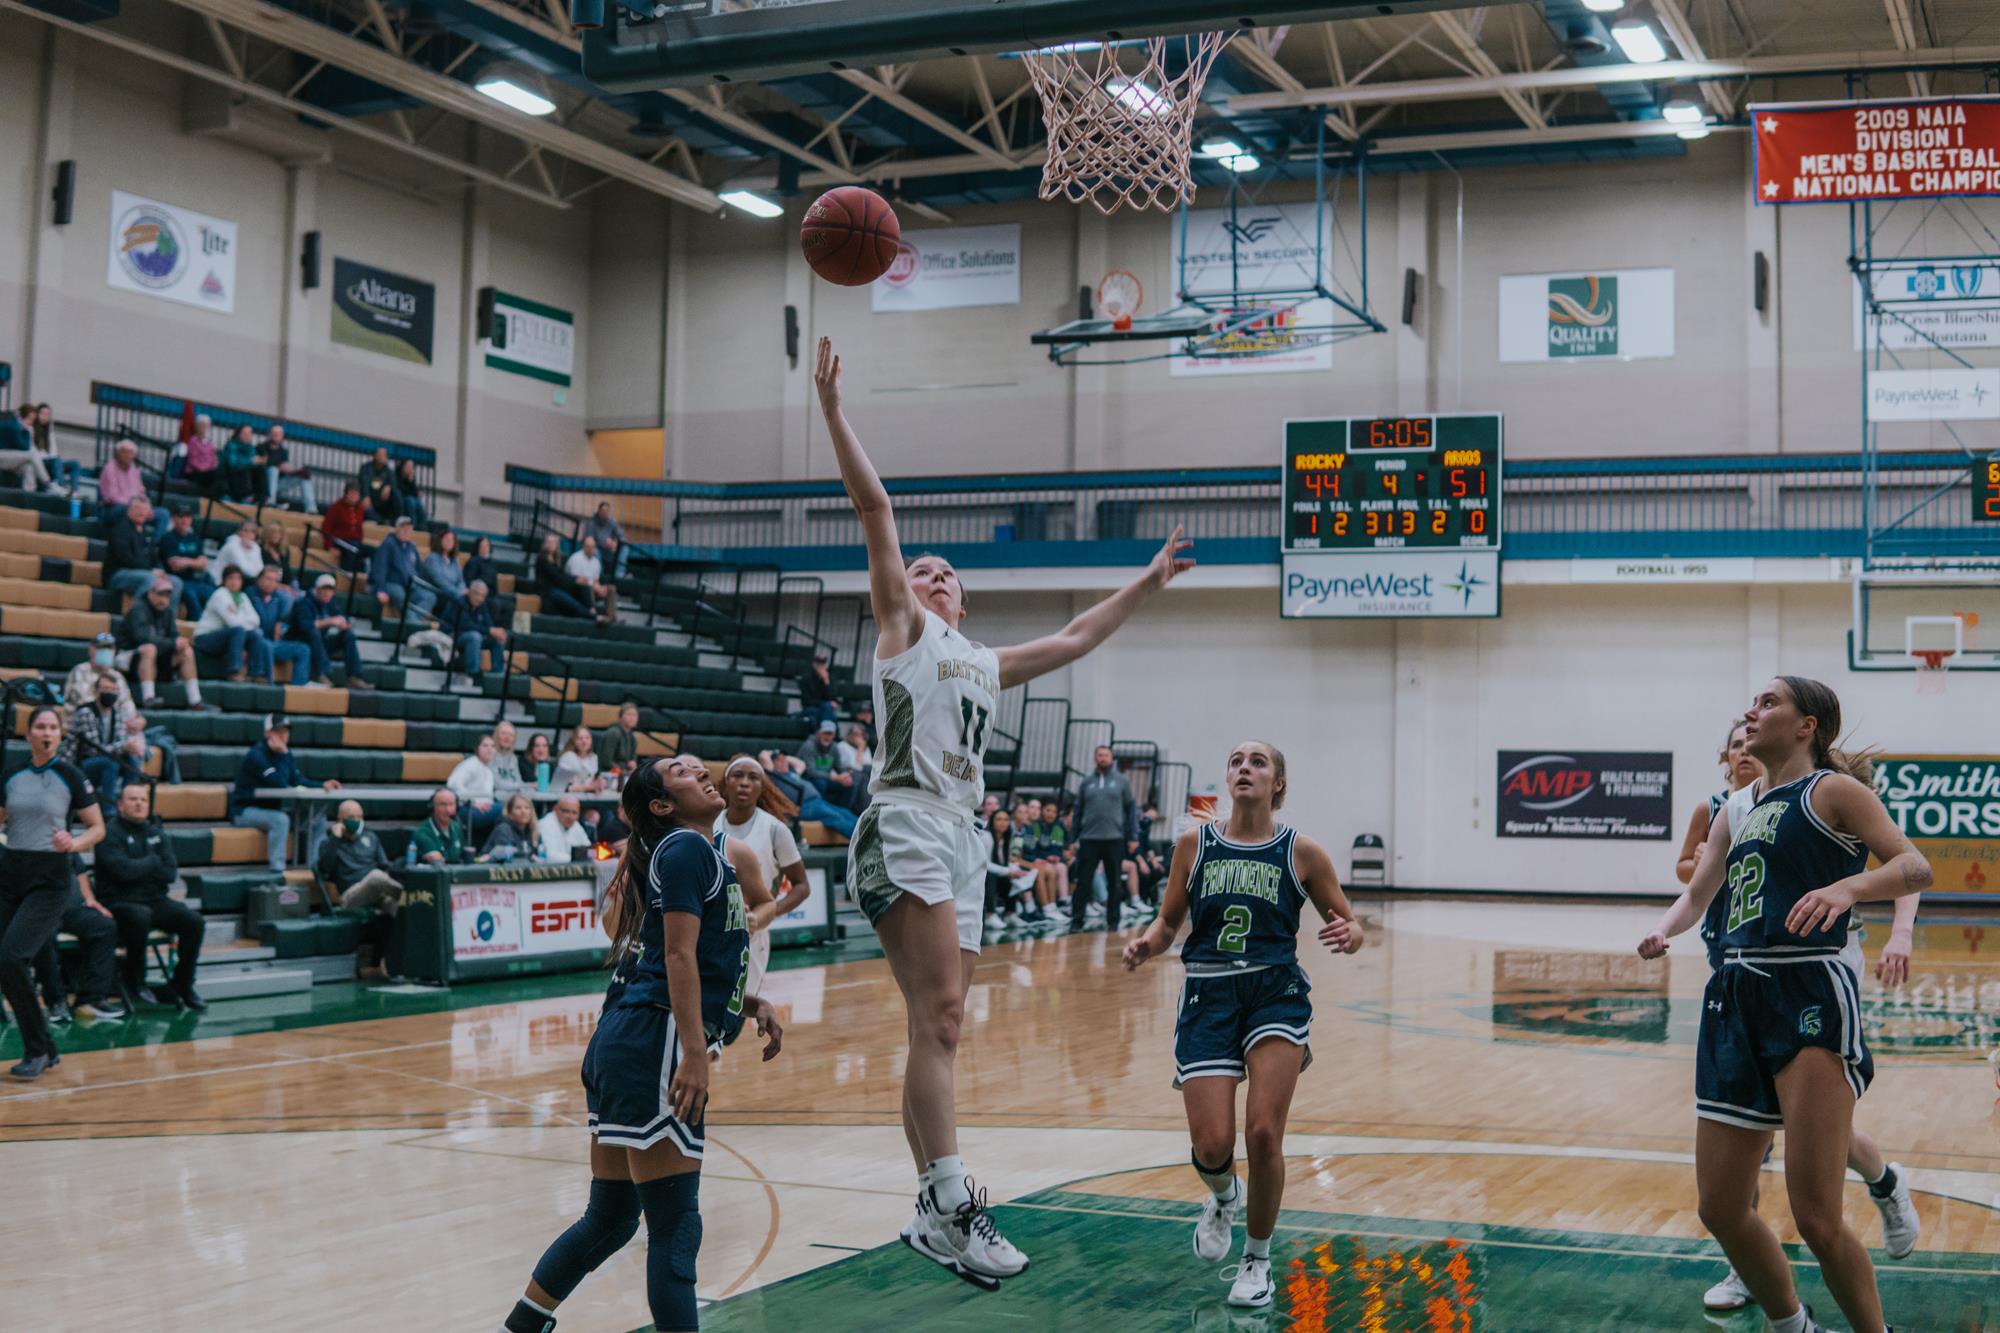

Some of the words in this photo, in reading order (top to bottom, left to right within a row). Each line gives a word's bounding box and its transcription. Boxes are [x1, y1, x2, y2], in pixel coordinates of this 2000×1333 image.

[1855, 107, 1909, 130] 2009
[1916, 105, 1966, 128] NAIA
[1856, 128, 1949, 151] DIVISION
[1957, 127, 1964, 147] I
[1800, 152, 1867, 175] MEN'S
[1793, 173, 1901, 197] NATIONAL
[922, 252, 957, 271] Office
[959, 248, 1016, 269] Solutions
[354, 278, 416, 315] Altana
[1550, 324, 1616, 346] QUALITY
[1570, 343, 1596, 354] INN
[1369, 420, 1429, 448] 6:05
[1295, 453, 1345, 470] ROCKY
[1375, 459, 1406, 471] PERIOD
[1305, 474, 1339, 497] 44
[1383, 474, 1398, 495] 4
[1450, 469, 1486, 497] 51
[1293, 502, 1321, 512] FOULS
[1360, 500, 1394, 511] PLAYER
[1397, 500, 1420, 511] FOUL
[1460, 498, 1488, 510] FOULS
[1311, 514, 1317, 534] 1
[1334, 512, 1348, 535] 2
[1432, 511, 1446, 535] 2
[1471, 510, 1484, 533] 0
[1374, 537, 1405, 547] MATCH
[1617, 564, 1675, 575] FOOTBALL
[1288, 573, 1433, 604] PayneWest
[1358, 602, 1432, 612] INSURANCE
[961, 694, 988, 756] 11
[1504, 769, 1592, 797] AMP
[1887, 763, 2000, 800] Smith
[1505, 820, 1548, 834] Sports
[1551, 822, 1609, 834] Medicine
[1611, 823, 1668, 835] Provider
[1200, 859, 1282, 905] PROVIDENCE
[1727, 852, 1765, 934] 22
[531, 898, 596, 934] ESPN
[1217, 904, 1252, 953] 2
